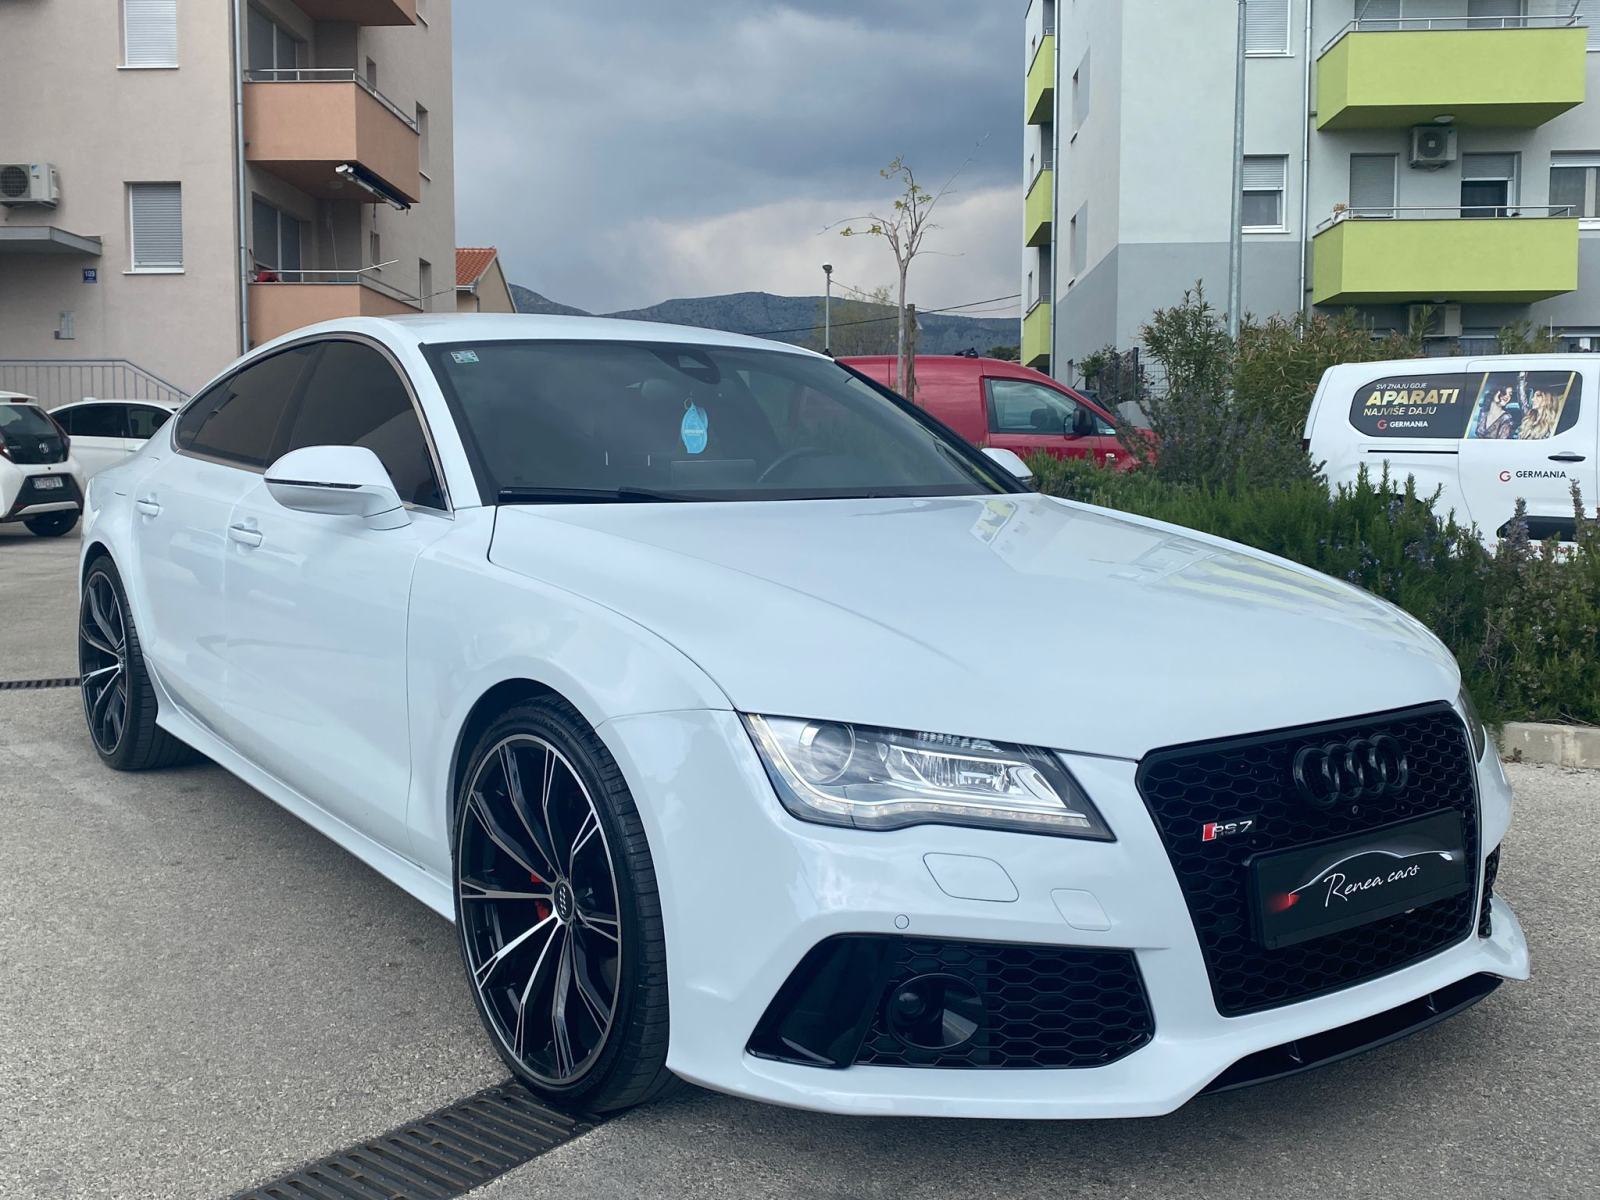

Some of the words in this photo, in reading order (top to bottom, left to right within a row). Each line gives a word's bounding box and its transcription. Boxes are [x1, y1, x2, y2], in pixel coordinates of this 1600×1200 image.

[1366, 388, 1460, 406] APARATI
[1363, 405, 1405, 416] NAJVIŠE
[1408, 406, 1437, 415] DAJU
[1389, 420, 1429, 428] GERMANIA
[1515, 470, 1567, 479] GERMANIA
[1323, 872, 1383, 908] Renea
[1387, 864, 1421, 884] cars
